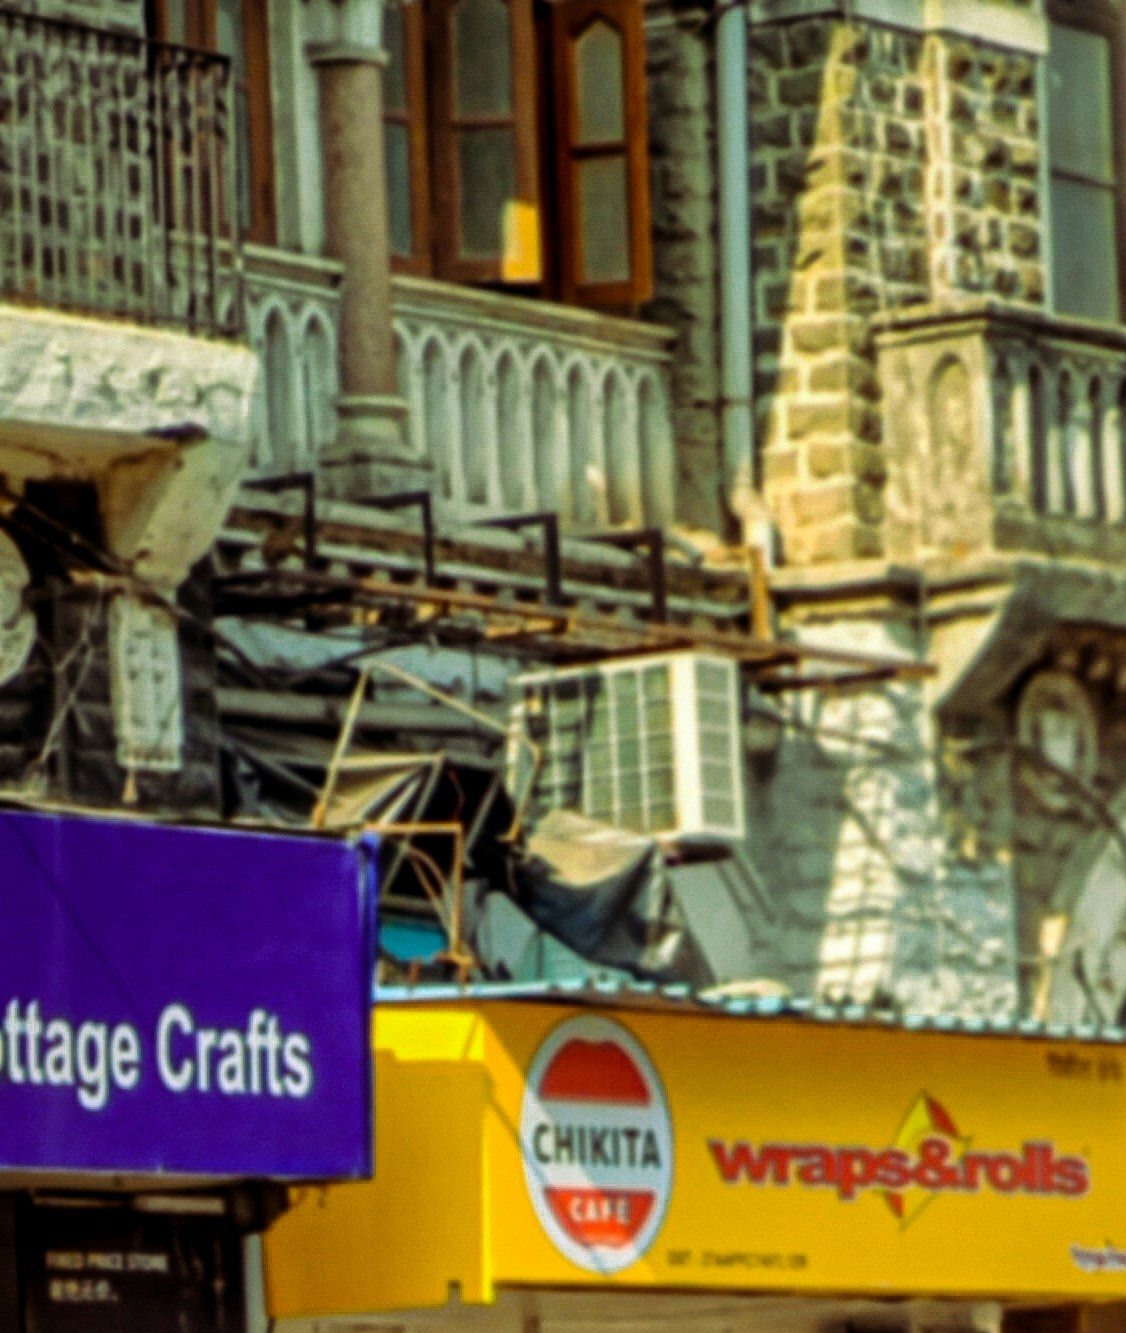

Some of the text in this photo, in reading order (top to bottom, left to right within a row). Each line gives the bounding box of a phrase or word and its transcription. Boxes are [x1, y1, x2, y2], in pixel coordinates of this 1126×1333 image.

[0, 997, 312, 1111] ttage Crafts
[532, 1124, 662, 1168] CHIKITA
[707, 1136, 1091, 1201] wraps&rolls
